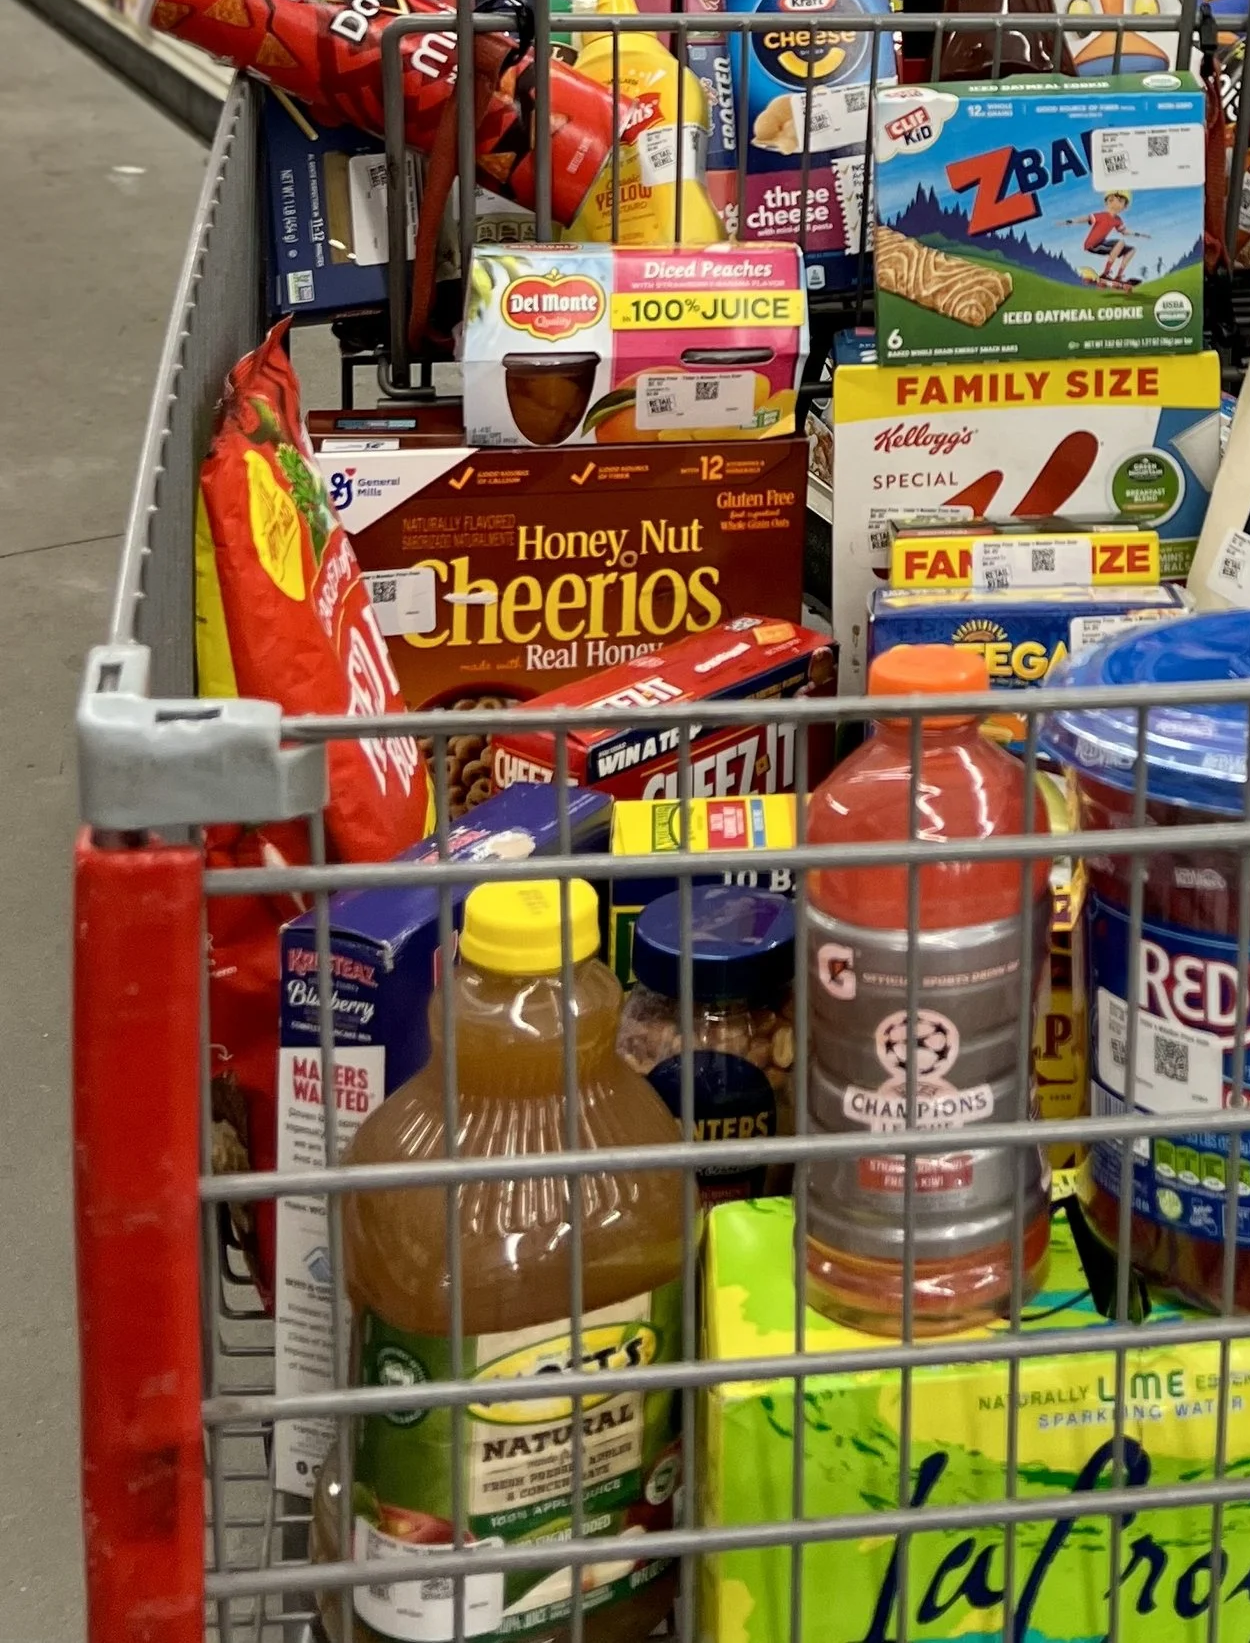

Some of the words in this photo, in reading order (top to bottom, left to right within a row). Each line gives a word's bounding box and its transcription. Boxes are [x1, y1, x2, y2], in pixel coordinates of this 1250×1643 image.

[891, 109, 928, 137] CLIF
[764, 185, 829, 208] three
[746, 206, 829, 229] cheese
[644, 262, 696, 279] Diced
[701, 262, 773, 278] Peaches
[510, 294, 539, 313] Del
[542, 295, 598, 313] Monte
[631, 299, 700, 323] 100%
[701, 297, 791, 320] JUICE
[1003, 312, 1032, 325] ICED
[1035, 310, 1095, 324] OATMEAL
[1098, 306, 1143, 321] COOKIE
[888, 329, 903, 349] 6
[896, 371, 1050, 406] FAMILY
[1065, 367, 1160, 399] SIZE
[874, 422, 974, 456] Kellogg's
[699, 455, 723, 481] 12
[872, 471, 959, 490] SPECIAL
[357, 476, 400, 487] General
[357, 487, 383, 497] Mills
[716, 490, 764, 509] Gluten
[765, 489, 795, 507] Free
[517, 523, 628, 566] Honey
[639, 518, 704, 554] Nut
[401, 555, 723, 649] Cheerios
[526, 642, 579, 671] Real
[598, 750, 641, 779] WIN
[817, 943, 857, 1000] G
[1138, 938, 1248, 1044] RED
[1096, 1369, 1187, 1404] LIME
